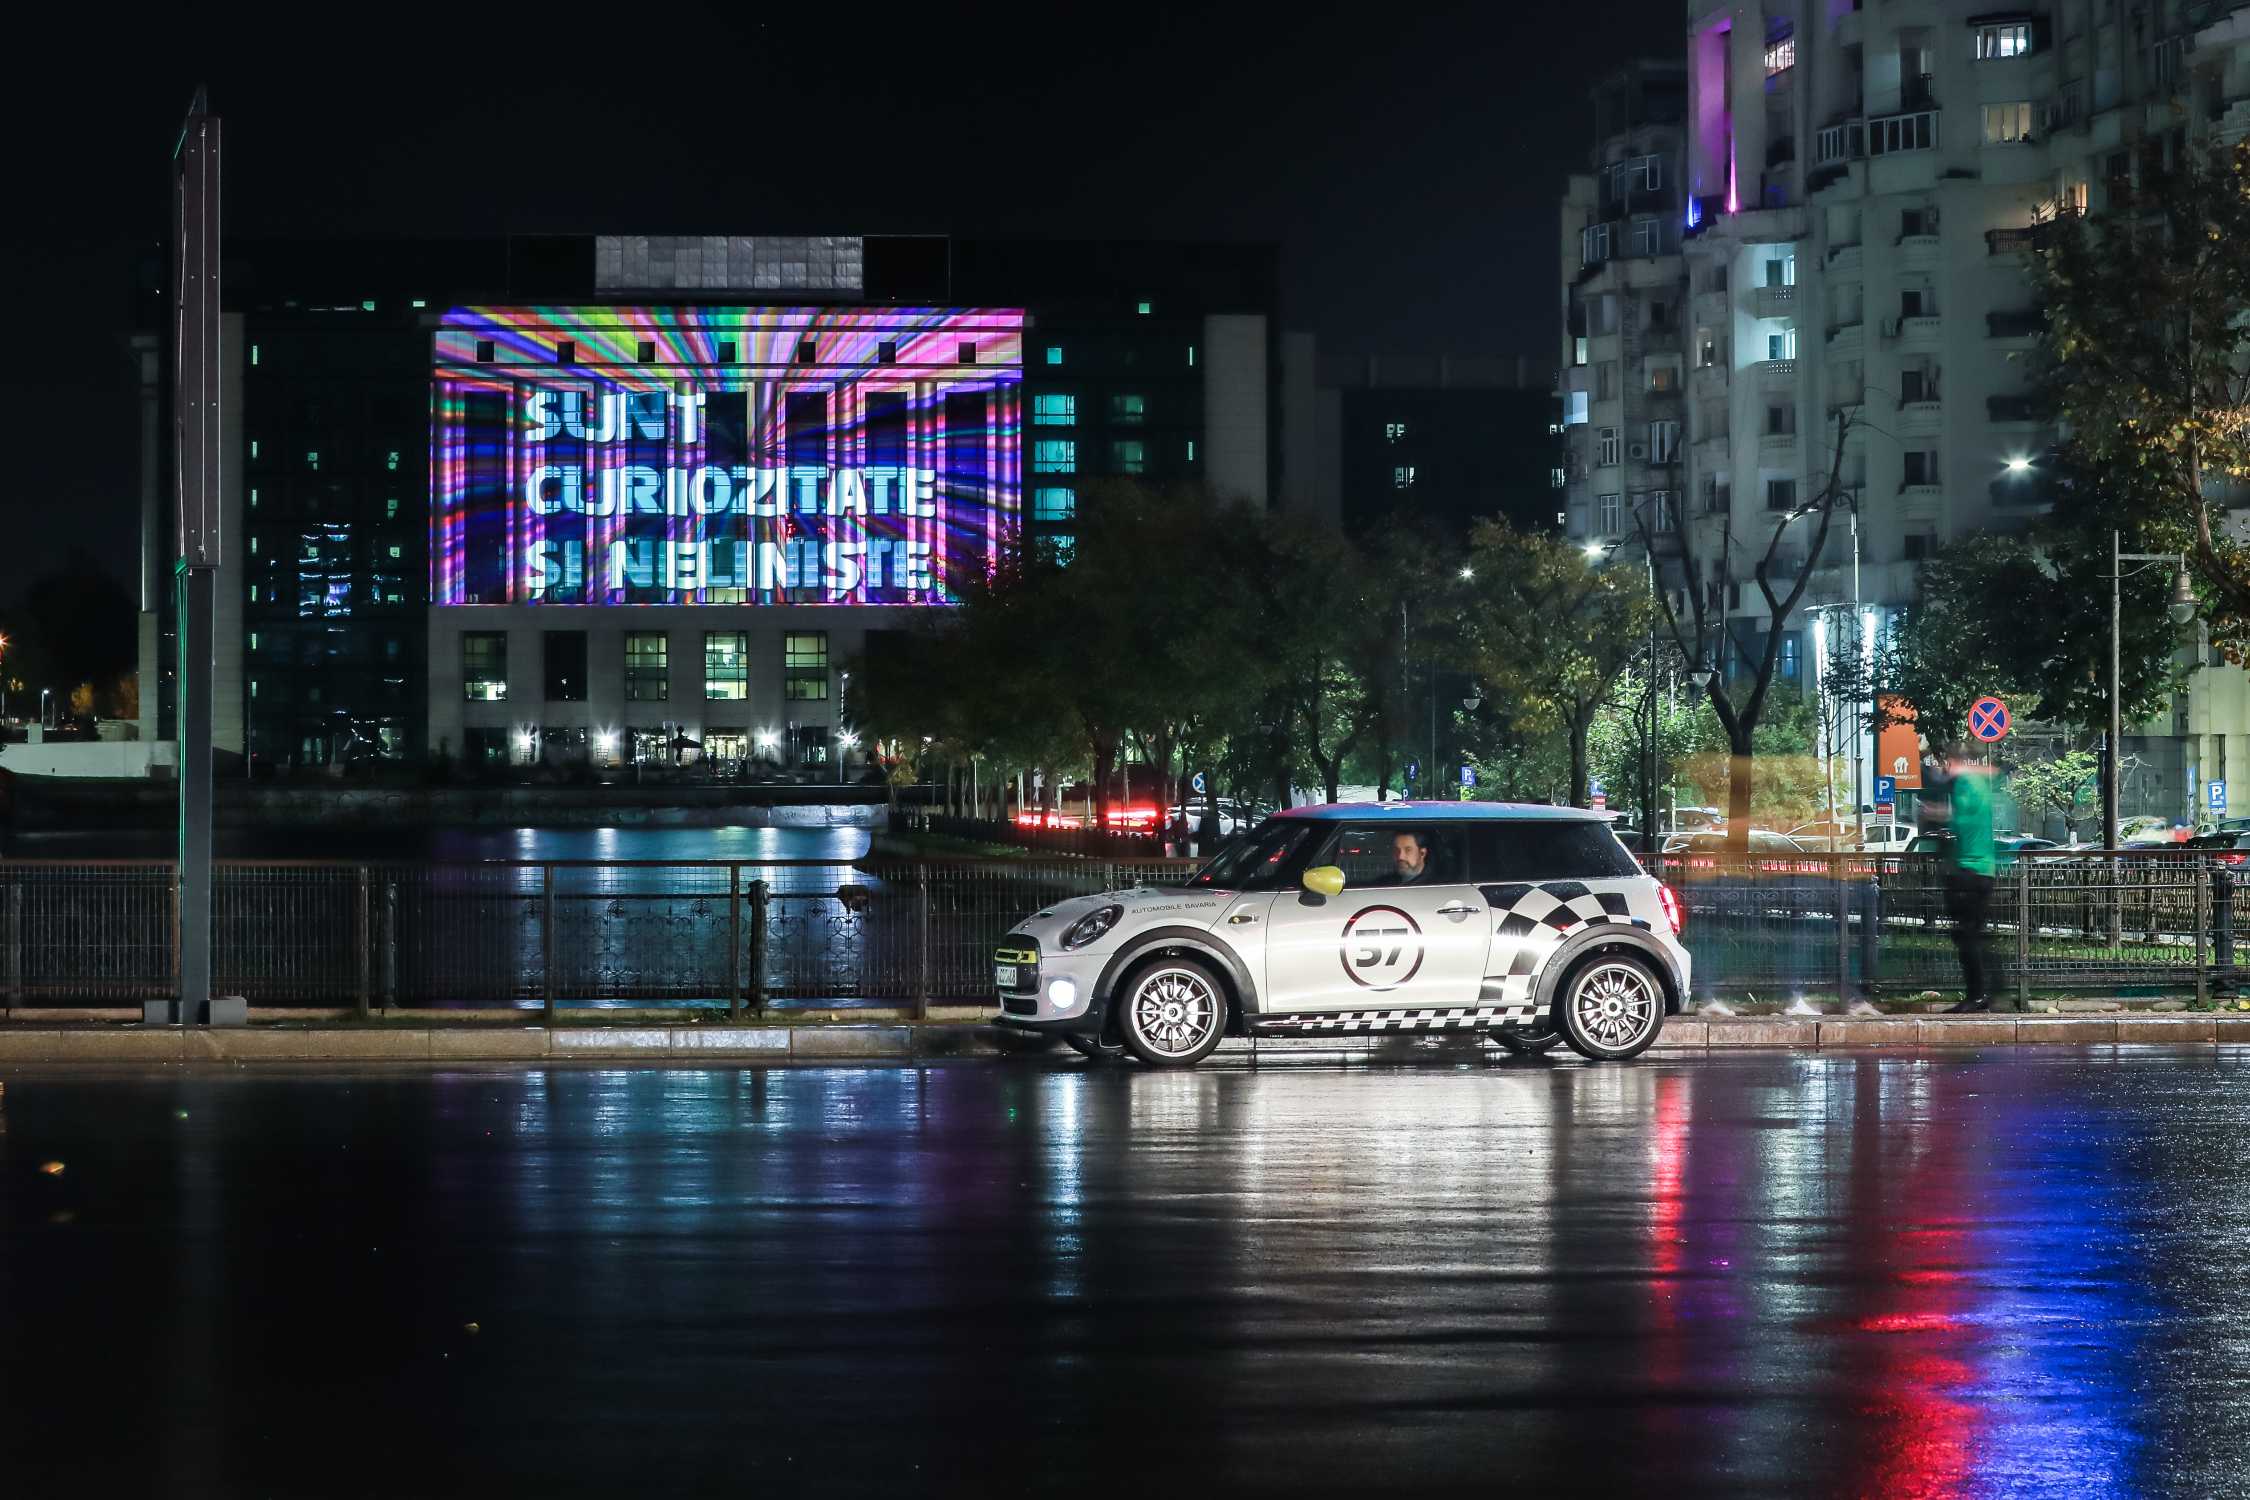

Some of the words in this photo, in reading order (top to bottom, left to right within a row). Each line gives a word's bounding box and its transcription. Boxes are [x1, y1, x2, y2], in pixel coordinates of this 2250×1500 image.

[525, 391, 706, 443] SUNT
[525, 465, 936, 518] CURIOZITATE
[1879, 780, 1890, 796] P
[2211, 785, 2223, 800] P
[1131, 903, 1182, 914] AUTOMOBILE
[1184, 901, 1217, 909] BAVARIA
[1355, 928, 1408, 968] 57
